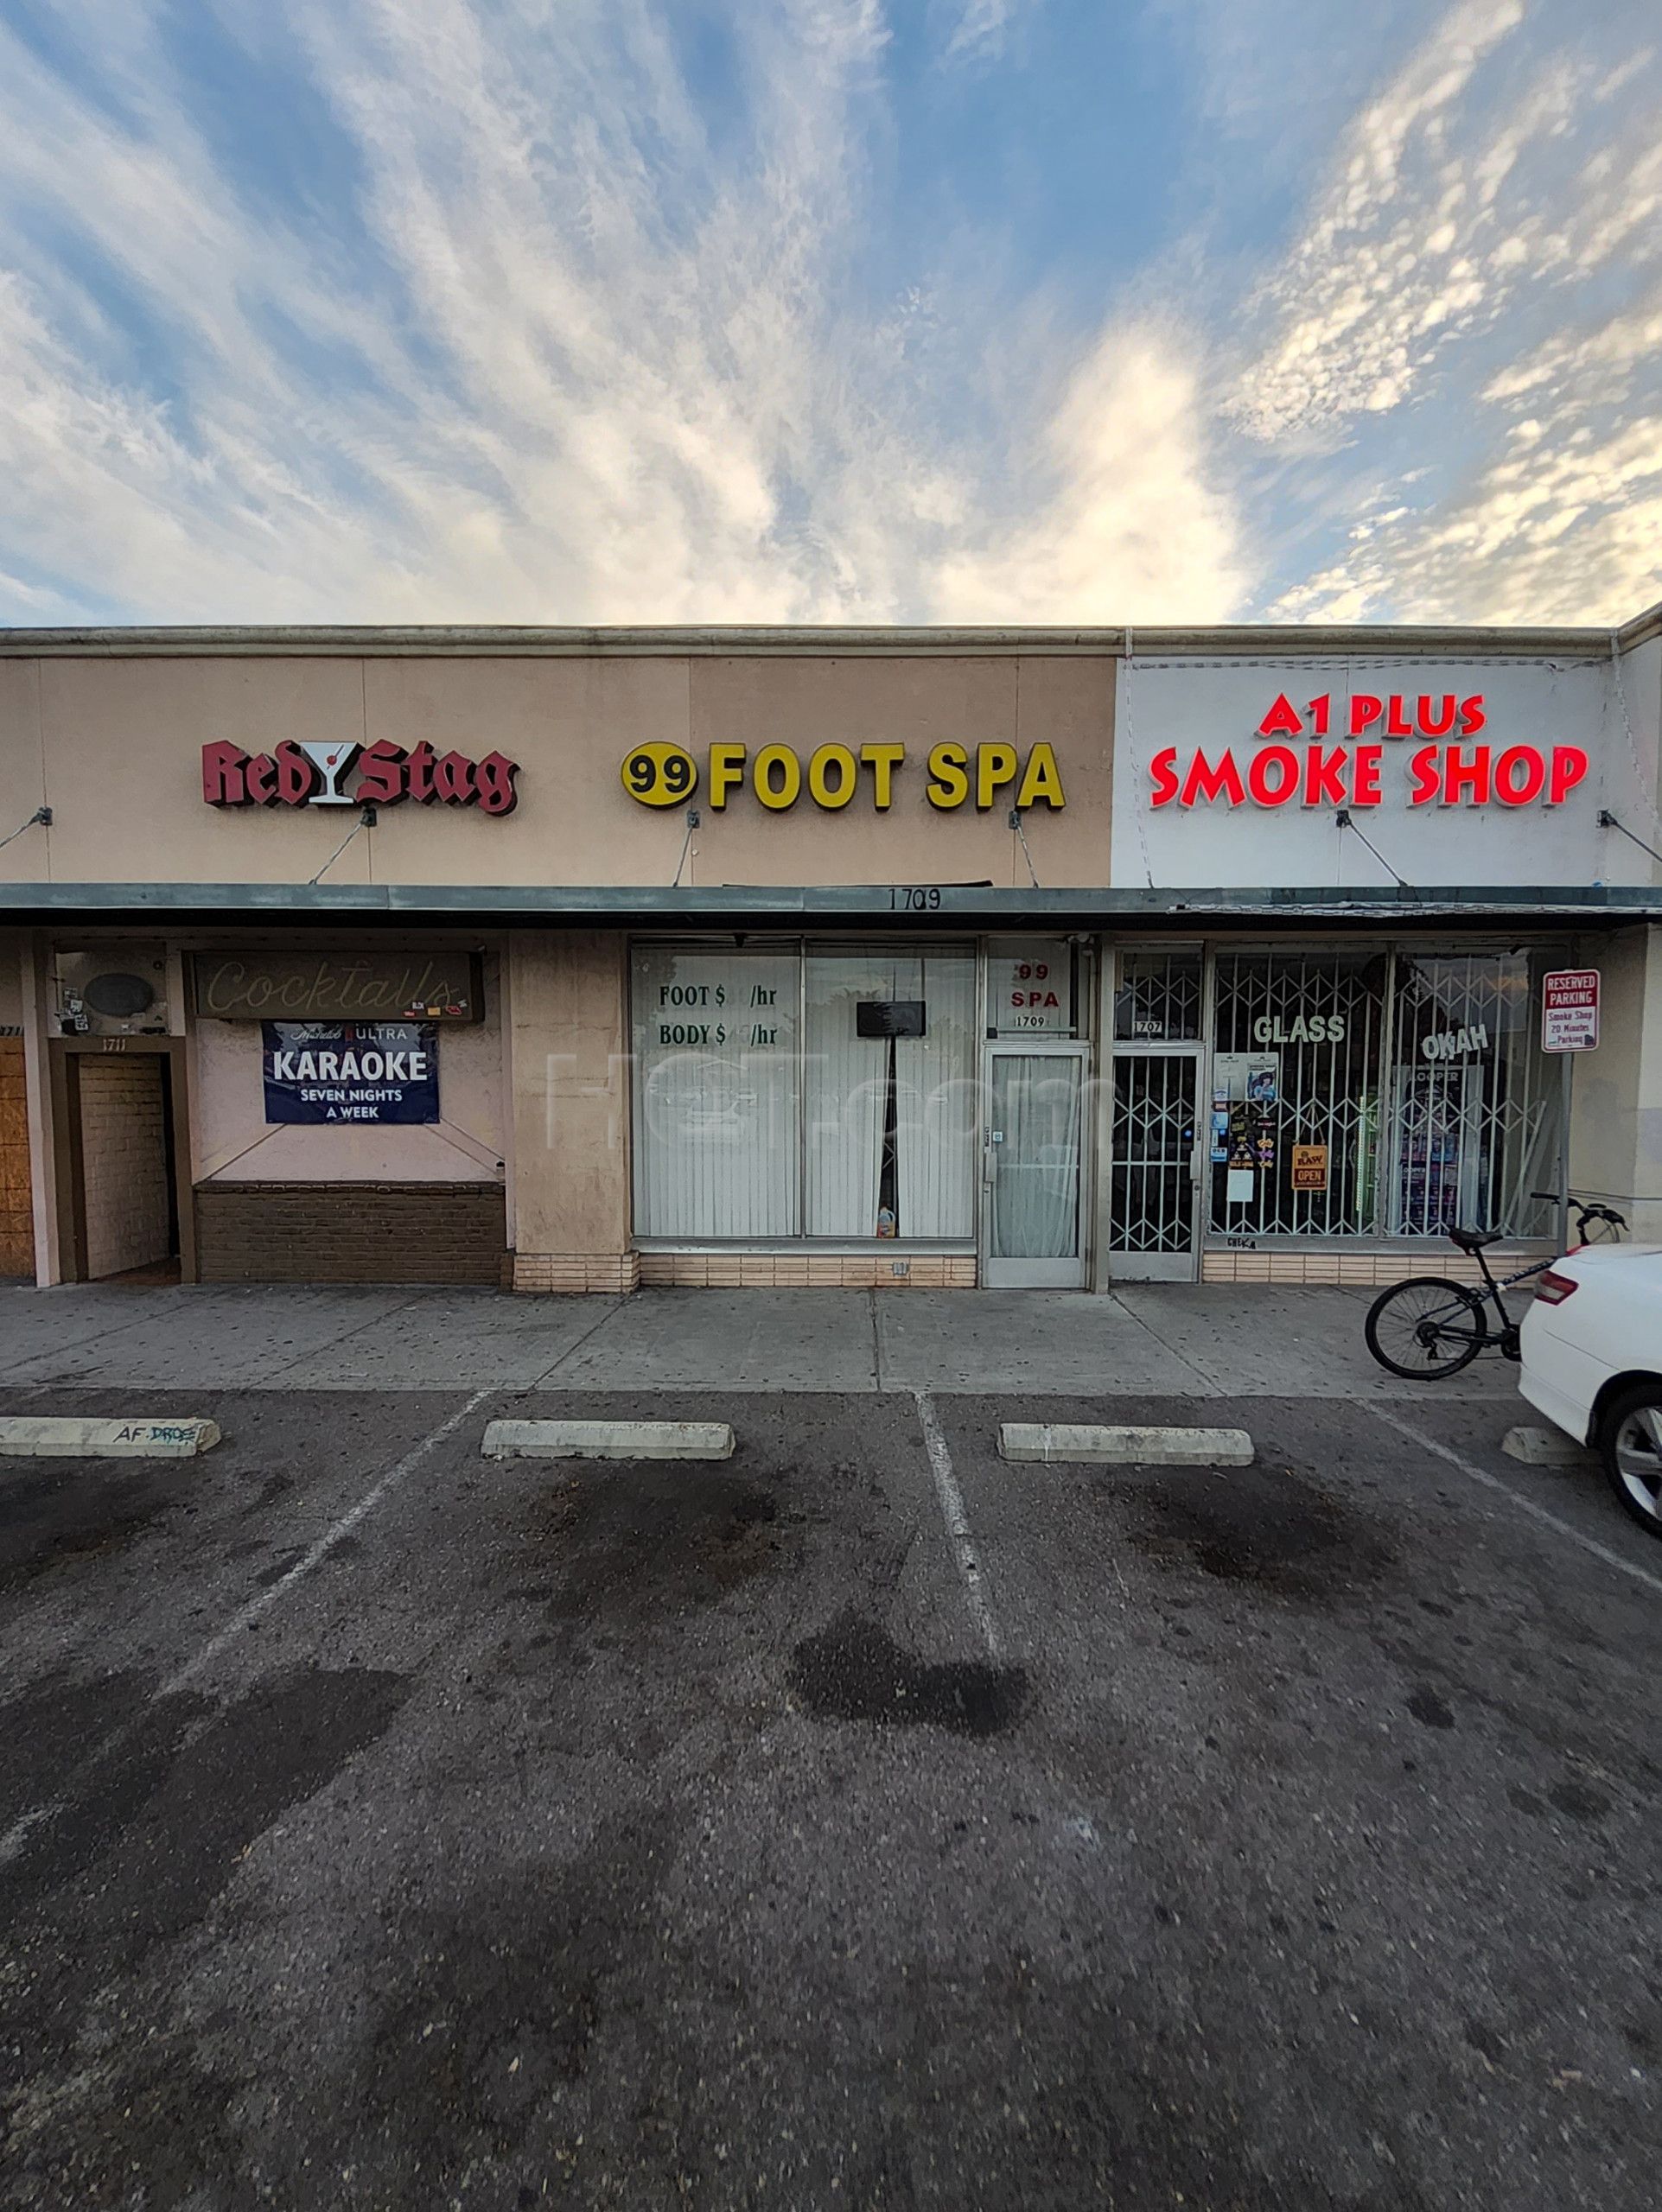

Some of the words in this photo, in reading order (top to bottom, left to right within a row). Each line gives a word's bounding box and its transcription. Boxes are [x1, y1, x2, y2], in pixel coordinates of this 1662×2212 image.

[1256, 692, 1331, 738] A1
[1346, 694, 1487, 739] PLUS
[202, 740, 314, 808] Red
[357, 739, 520, 816] Stag
[629, 755, 691, 793] 99
[709, 742, 905, 811] FOOT
[926, 742, 1066, 810] SPA
[1149, 745, 1383, 809] SMOKE
[1408, 745, 1589, 808] SHOP
[1018, 963, 1048, 980] 99
[1547, 976, 1595, 990] RESERVED
[659, 986, 710, 1006] FOOT
[715, 984, 725, 1007] $
[750, 985, 777, 1007] /hr
[1011, 992, 1059, 1007] SPA
[1550, 991, 1592, 1006] PARKING
[1017, 1016, 1045, 1027] 1709
[1134, 1021, 1162, 1032] 1707
[1254, 1015, 1345, 1043] GLASS
[355, 1027, 408, 1039] ULTRA
[659, 1025, 710, 1045] BODY
[716, 1023, 726, 1046] $
[751, 1024, 777, 1046] /hr
[103, 1039, 126, 1052] 1711
[1422, 1024, 1489, 1060] OKAH
[273, 1052, 428, 1080] KARAOKE
[301, 1090, 345, 1102] SEVEN
[349, 1090, 403, 1102] NIGHTS
[326, 1107, 338, 1118] A
[341, 1107, 379, 1118] WEEK
[1297, 1154, 1323, 1166] RAW
[1298, 1171, 1321, 1181] OPEN
